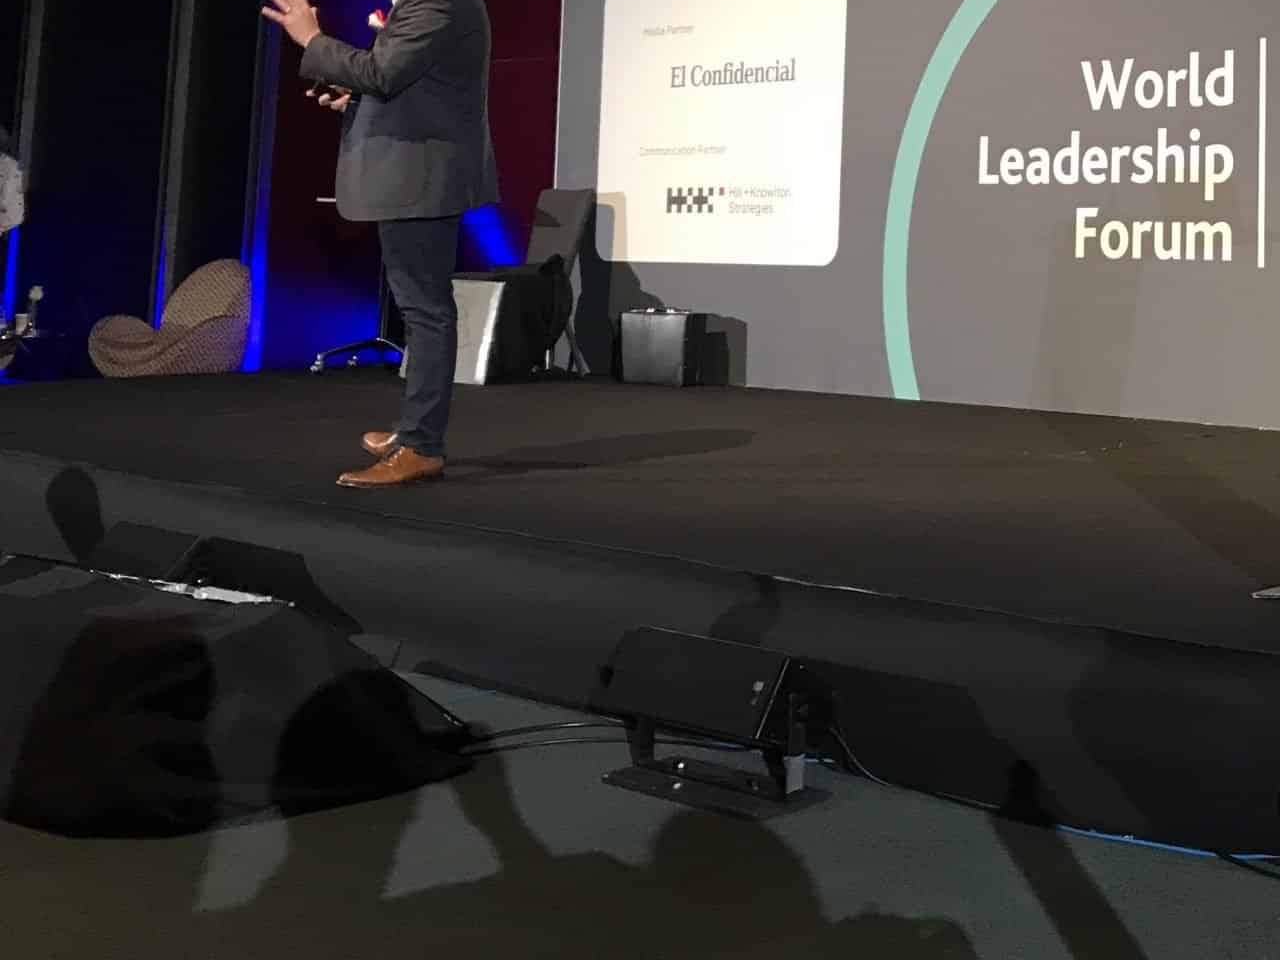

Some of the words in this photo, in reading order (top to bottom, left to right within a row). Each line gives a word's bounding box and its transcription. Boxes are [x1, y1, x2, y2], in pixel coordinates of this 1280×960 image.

[670, 65, 686, 88] El
[690, 58, 796, 87] Confidencial
[1081, 49, 1235, 111] World
[978, 127, 1235, 201] Leadership
[1074, 208, 1233, 262] Forum
